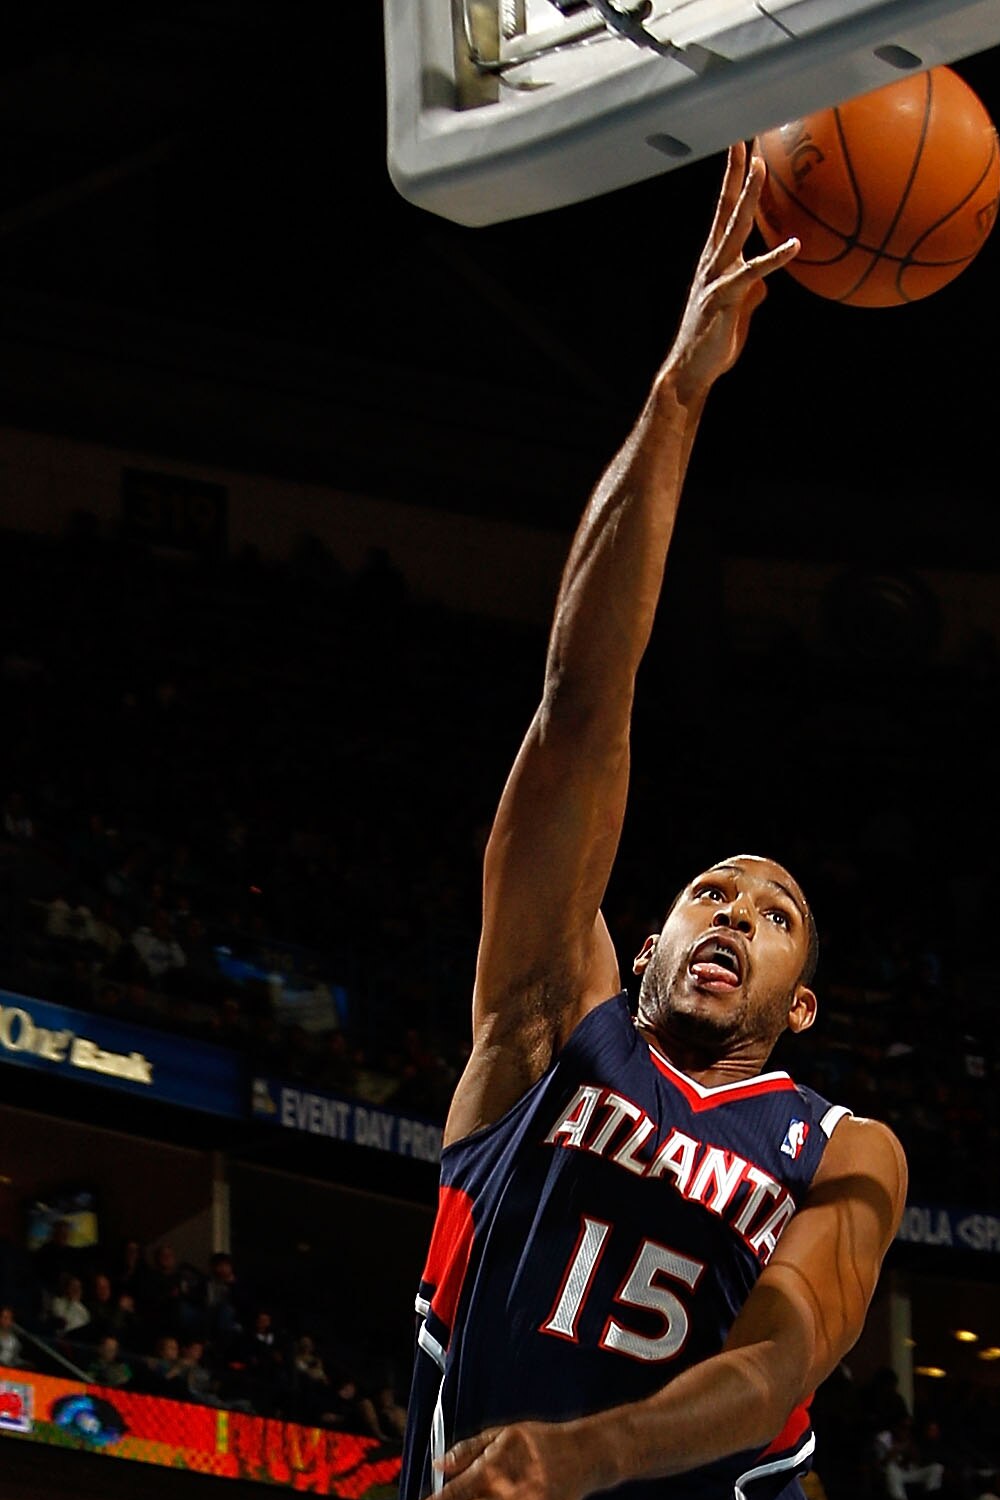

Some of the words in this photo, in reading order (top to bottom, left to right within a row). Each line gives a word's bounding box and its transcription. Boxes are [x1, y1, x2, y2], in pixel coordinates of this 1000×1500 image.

[281, 1086, 351, 1141] EVENT
[353, 1105, 395, 1152] DAY
[539, 1217, 704, 1366] 15
